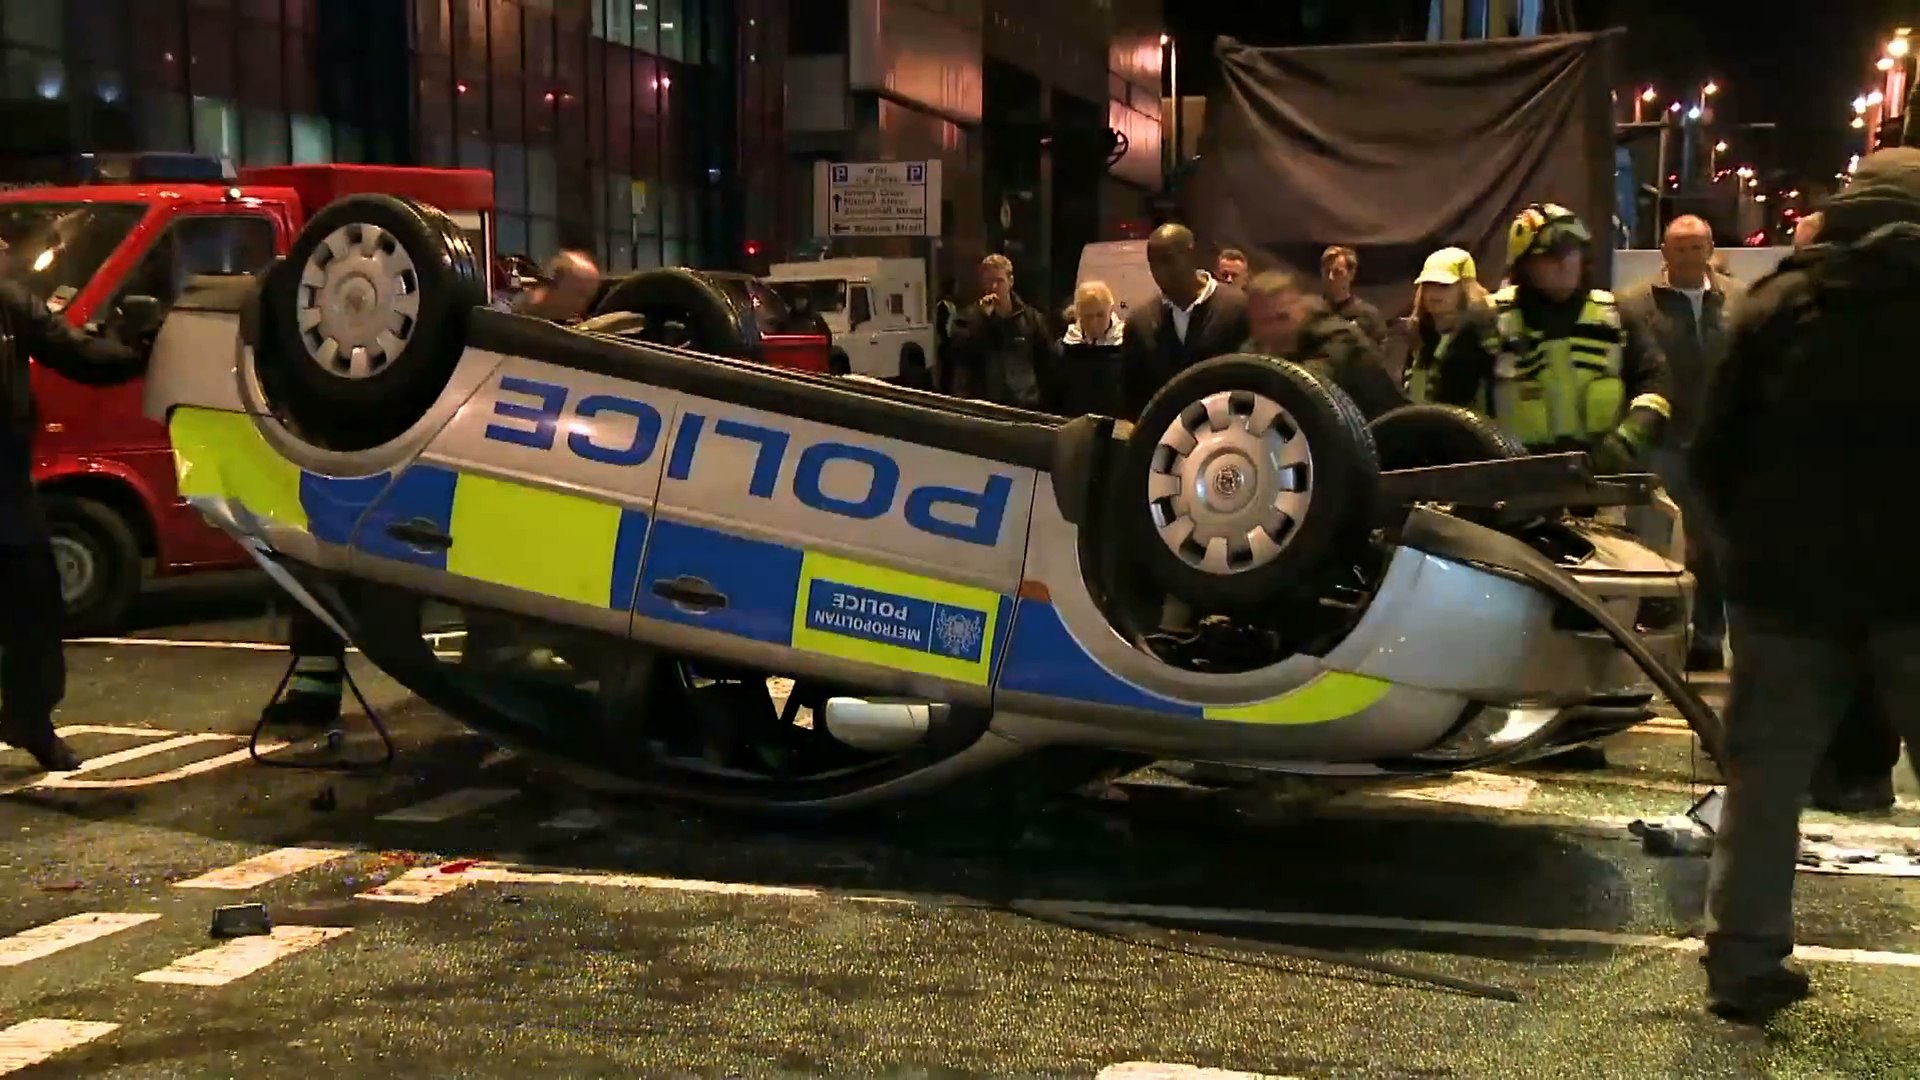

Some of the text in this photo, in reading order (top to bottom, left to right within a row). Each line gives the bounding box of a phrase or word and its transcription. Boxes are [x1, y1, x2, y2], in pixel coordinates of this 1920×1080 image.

[485, 375, 1013, 547] POLICE
[832, 593, 909, 621] POLICE
[815, 610, 921, 642] METROPOLITAN
